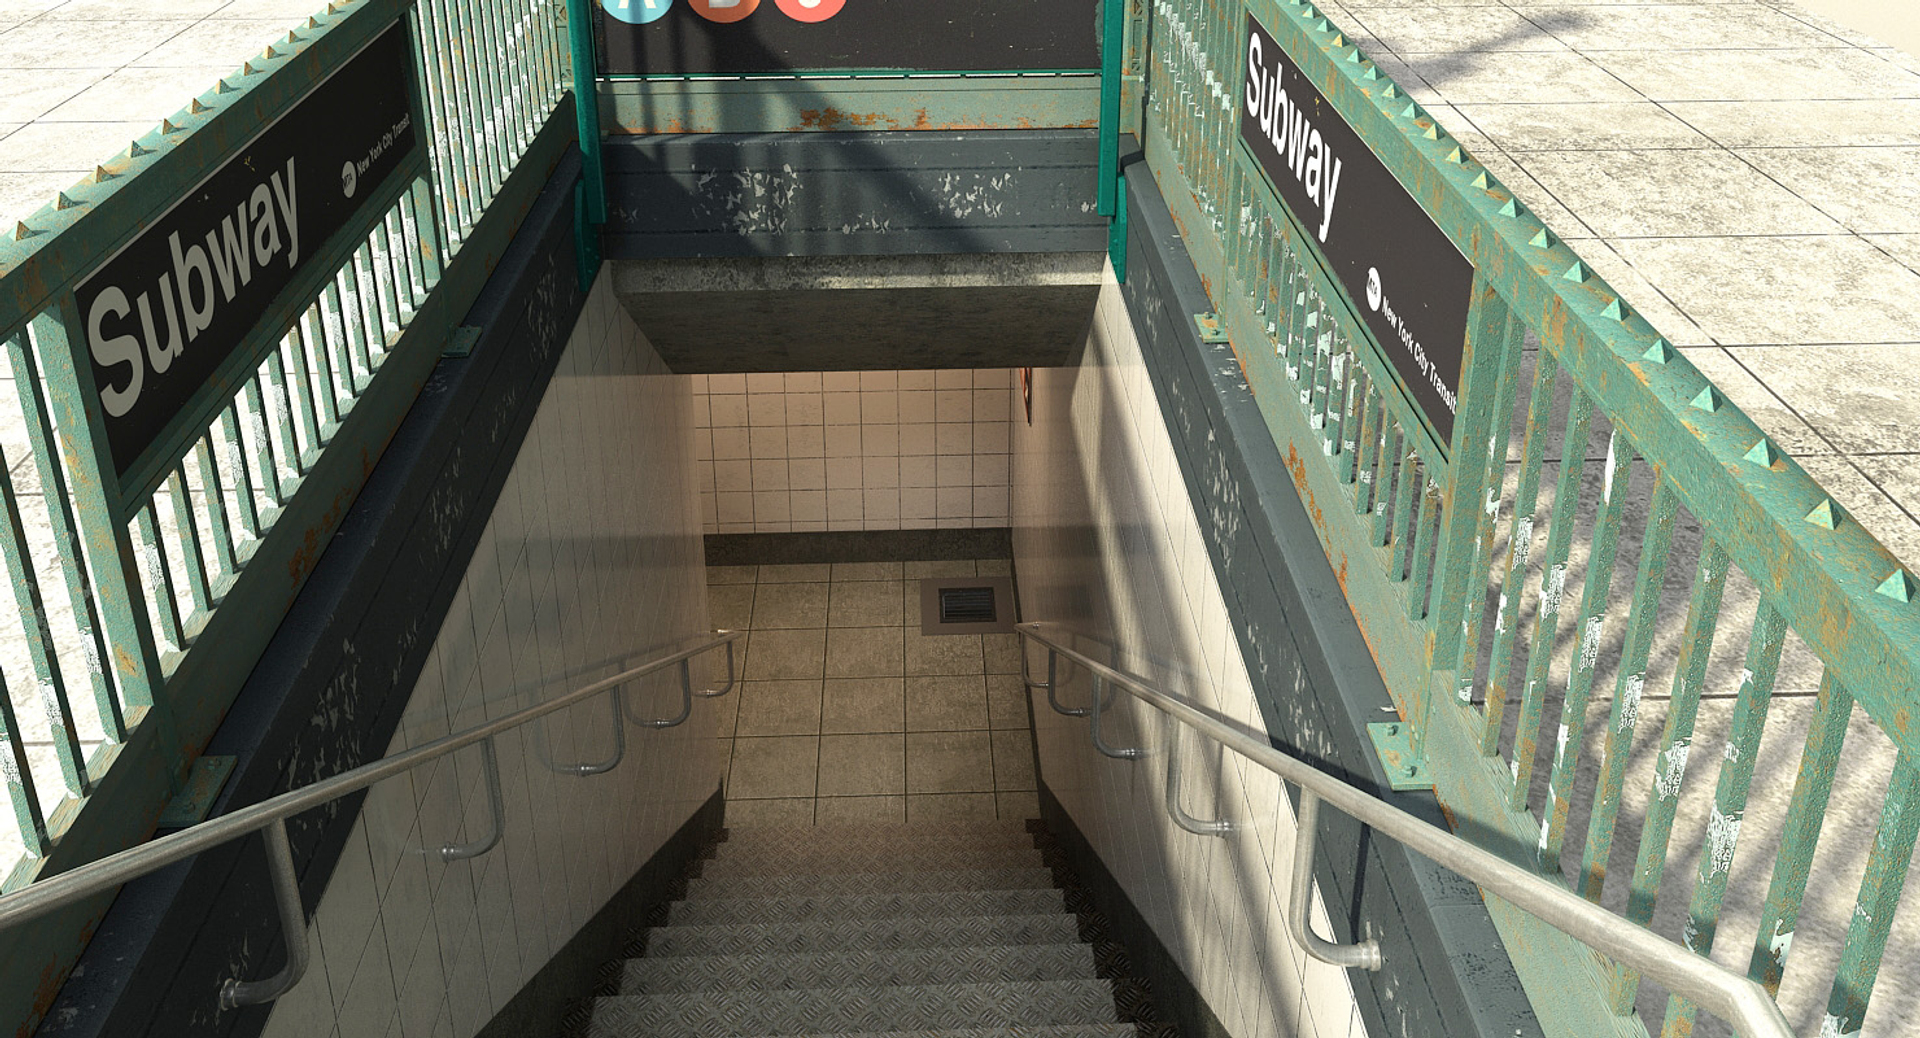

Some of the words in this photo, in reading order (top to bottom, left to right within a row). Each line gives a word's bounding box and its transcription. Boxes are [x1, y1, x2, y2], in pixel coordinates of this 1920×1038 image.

[356, 155, 370, 177] New
[369, 141, 383, 162] York
[382, 132, 393, 149] City
[392, 112, 410, 139] Transit
[1246, 32, 1342, 243] Subway
[88, 156, 298, 417] Subway
[1382, 295, 1398, 329] New
[1398, 316, 1414, 354] York
[1414, 342, 1429, 376] City
[1429, 361, 1457, 415] Transit
